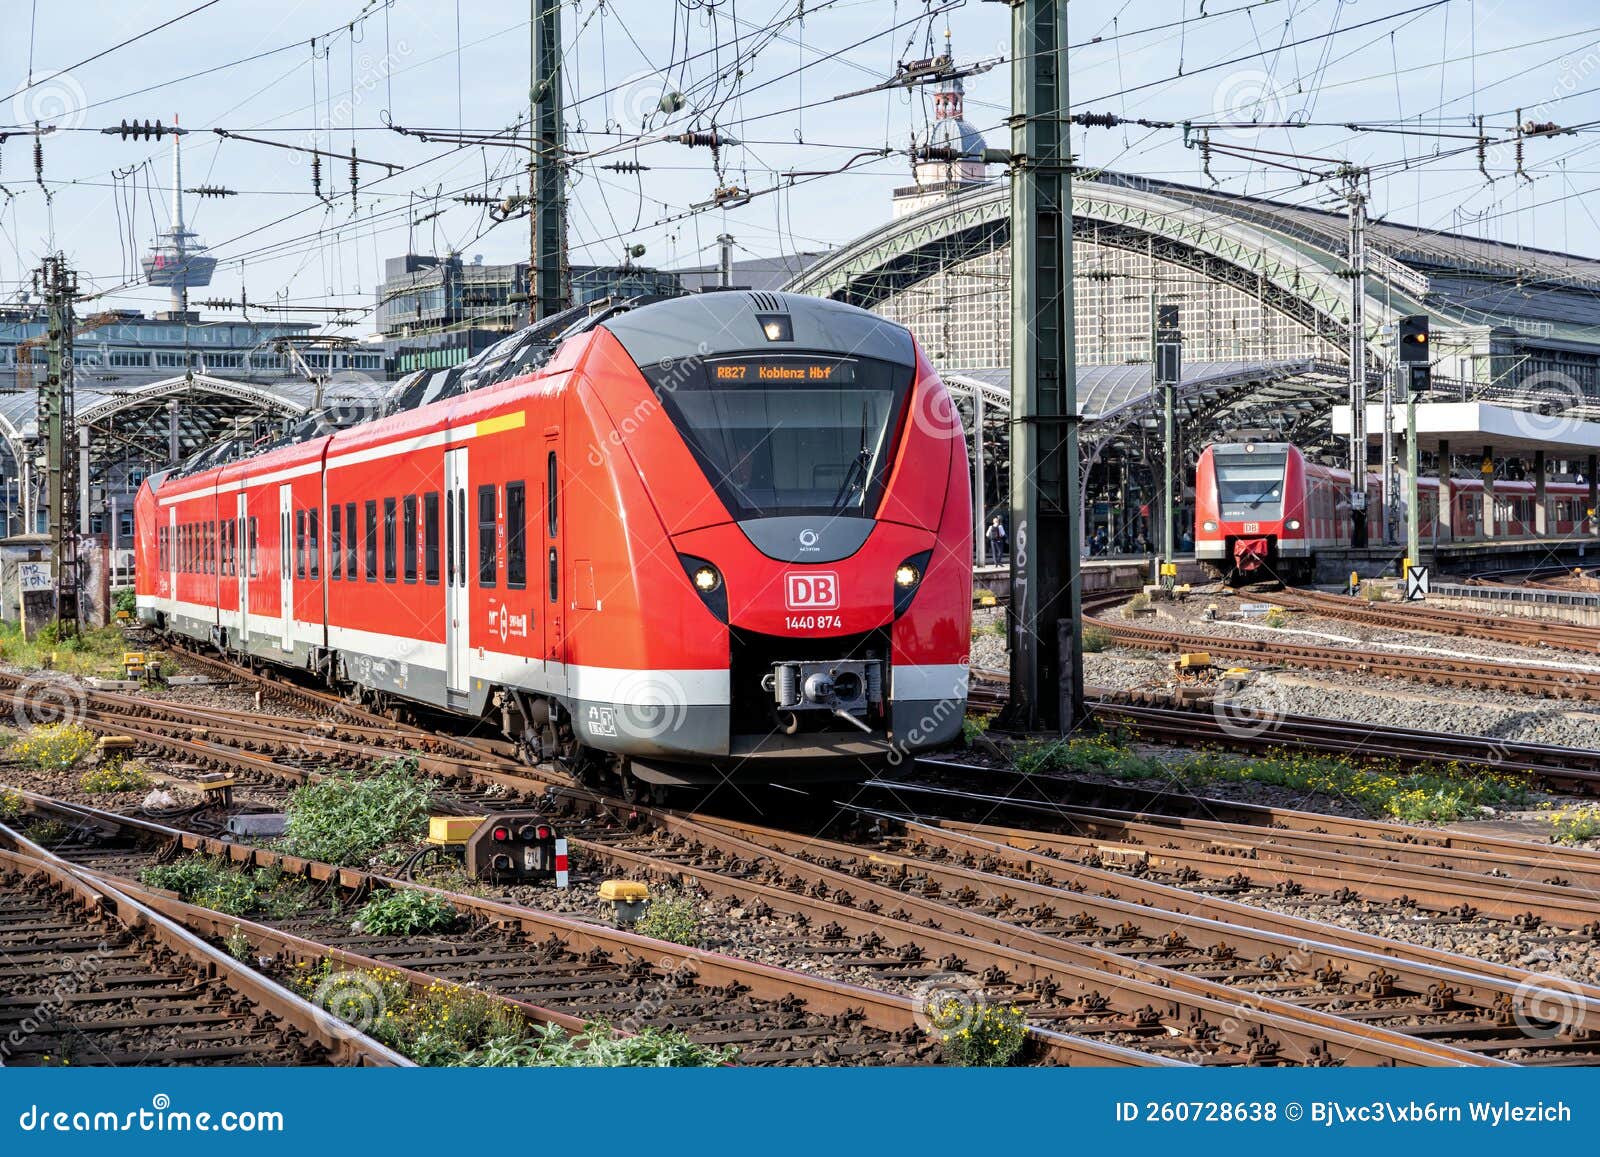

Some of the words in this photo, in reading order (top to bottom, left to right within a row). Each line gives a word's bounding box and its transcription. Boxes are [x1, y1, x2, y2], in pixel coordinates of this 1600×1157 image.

[717, 367, 746, 378] RB27
[759, 366, 805, 378] Koblenz
[809, 366, 831, 378] Hbf
[792, 577, 833, 604] DB
[785, 616, 815, 630] 1440
[817, 615, 842, 629] 874
